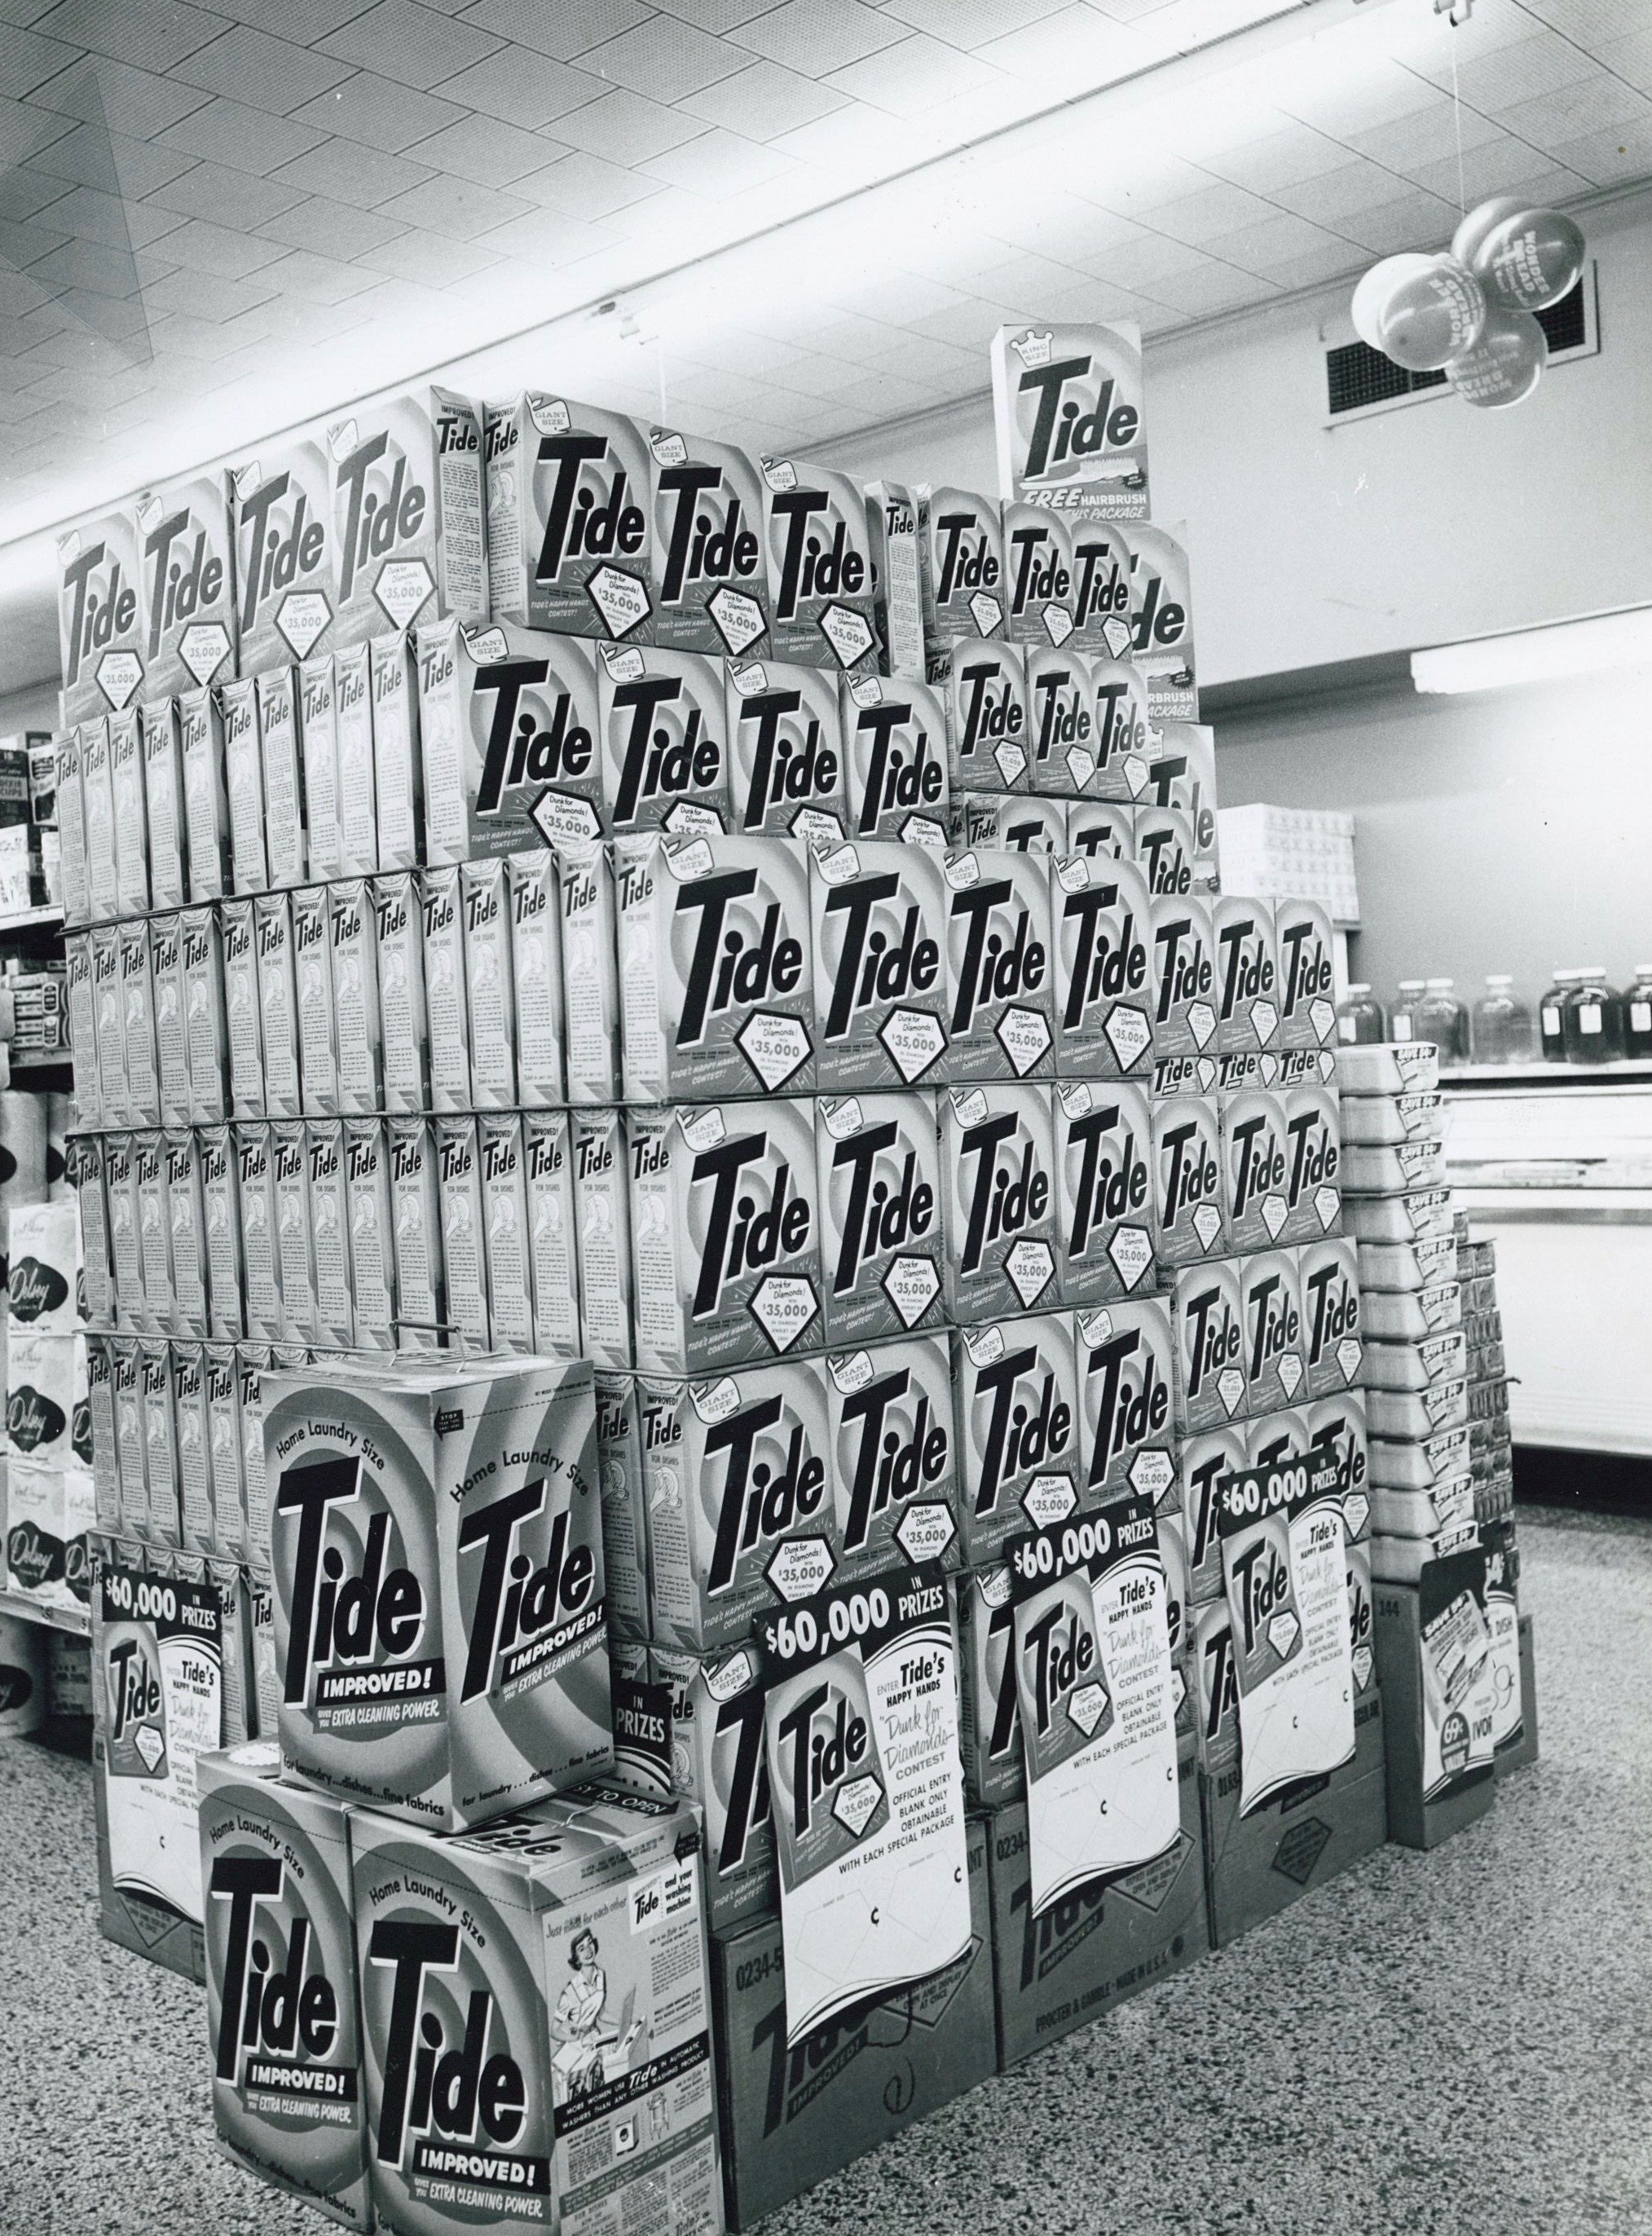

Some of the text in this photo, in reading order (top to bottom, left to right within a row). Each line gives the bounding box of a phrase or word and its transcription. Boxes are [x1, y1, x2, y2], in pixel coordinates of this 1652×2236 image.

[1022, 342, 1049, 356] KING
[535, 410, 567, 423] GIANT
[1019, 356, 1139, 479] Tide
[654, 444, 684, 457] GIANT
[535, 437, 645, 580] Tide
[1024, 488, 1147, 509] FREE HAIRBRUSH
[1089, 506, 1146, 520] PACKAGE
[337, 429, 426, 606] Tide
[659, 467, 759, 602] Tide
[240, 470, 324, 635] Tide
[771, 491, 865, 618] Tide
[145, 507, 222, 663] Tide
[598, 589, 641, 614] $35,000
[64, 541, 136, 689] Tide
[717, 608, 758, 633] $35,000
[473, 659, 593, 814] Tide
[611, 677, 720, 823] Tide
[738, 690, 838, 830] Tide
[856, 703, 943, 834] Tide
[675, 868, 803, 1047] Tide
[825, 872, 939, 1040] Tide
[950, 880, 1046, 1035] Tide
[1063, 884, 1146, 1031] Tide
[960, 1111, 1048, 1274] Tide
[1068, 1105, 1148, 1258] Tide
[692, 1131, 809, 1318] Tide
[833, 1120, 934, 1294] Tide
[699, 1389, 736, 1408] GIANT
[707, 1398, 733, 1414] SIZE
[1088, 1327, 1169, 1488] Tide
[276, 1420, 385, 1471] Home Laundry Size
[975, 1345, 1070, 1516] Tide
[450, 1447, 588, 1503] Home Laundry Size
[841, 1367, 947, 1554] Tide
[704, 1394, 826, 1594] Tide
[1222, 1466, 1307, 1516] $60,000
[1311, 1466, 1337, 1493] PRIZES
[1117, 1517, 1153, 1548] PRIZES
[1128, 1508, 1137, 1521] IN
[1310, 1519, 1337, 1545] Tide's
[784, 1545, 800, 1555] Dunk
[905, 1529, 946, 1545] $35,000
[1014, 1518, 1111, 1579] $60,000
[778, 1567, 825, 1581] $35,000
[789, 1550, 822, 1563] Diamonds!
[106, 1576, 177, 1622] $60,000
[277, 1456, 424, 1705] Tide
[459, 1478, 594, 1704] Tide
[911, 1576, 923, 1590] IN
[1119, 1576, 1156, 1607] Tide's
[1232, 1537, 1288, 1657] Tide
[181, 1605, 216, 1630] PRIZES
[192, 1594, 200, 1606] IN
[703, 1590, 769, 1629] TIDE'S HAPPY HANDS
[898, 1585, 944, 1621] PRIZES
[1109, 1600, 1152, 1624] HAPPY HANDS
[724, 1608, 756, 1630] CONTEST!
[765, 1588, 889, 1658] $60,000
[510, 1605, 603, 1674] IMPROVED!
[182, 1660, 214, 1687] Tide's
[324, 1666, 432, 1699] IMPROVED!
[518, 1670, 541, 1694] EXTRA
[543, 1648, 580, 1680] CLEANING
[659, 1669, 690, 1684] IMPROVED!
[719, 1671, 745, 1690] SIZE
[877, 1652, 945, 1696] ENTER Tide's
[1024, 1599, 1094, 1737] Tide
[1119, 1665, 1159, 1688] CONTEST
[110, 1639, 161, 1740] Tide
[633, 1695, 643, 1709] IN
[887, 1678, 941, 1708] HAPPY HANDS
[1117, 1683, 1164, 1711] OFFICIAL ENTRY
[332, 1700, 440, 1727] EXTRA CLEANING POWER
[615, 1708, 665, 1743] PRIZES
[1122, 1699, 1162, 1722] BLANK ONLY
[1124, 1711, 1161, 1735] OBTAINABLE
[779, 1681, 867, 1841] Tide
[1073, 1721, 1167, 1769] WITH EACH SPECIAL PACKAGE
[896, 1752, 945, 1780] CONTEST
[602, 1789, 667, 1815] TO OPEN
[892, 1772, 951, 1806] OFFICIAL ENTRY
[899, 1789, 948, 1818] BLANK ONLY
[901, 1804, 947, 1832] OBTAINABLE
[209, 1815, 304, 1879] Home Laundry Size
[839, 1815, 955, 1874] WITH EACH SPECIAL PACKAGE
[665, 1869, 693, 1888] and your
[665, 1883, 691, 1900] washing
[369, 1875, 487, 1948] Home Laundry Size
[666, 1896, 691, 1914] machine
[210, 1857, 337, 2081] Tide
[370, 1920, 526, 2165] Tide
[253, 2065, 345, 2095] IMPROVED!
[562, 2111, 591, 2129] WASHERS
[594, 2101, 611, 2112] THAN
[615, 2093, 627, 2103] ANY
[630, 2082, 649, 2096] OTHER
[681, 2050, 704, 2067] PRODUCT
[566, 2101, 584, 2115] MORE
[588, 2088, 612, 2105] WOMEN
[615, 2082, 625, 2093] USE
[259, 2096, 280, 2111] EXTRA
[282, 2099, 319, 2118] CLEANING
[421, 2149, 535, 2187] IMPROVED!
[430, 2183, 455, 2200] EXTRA
[456, 2185, 503, 2209] CLEANING
